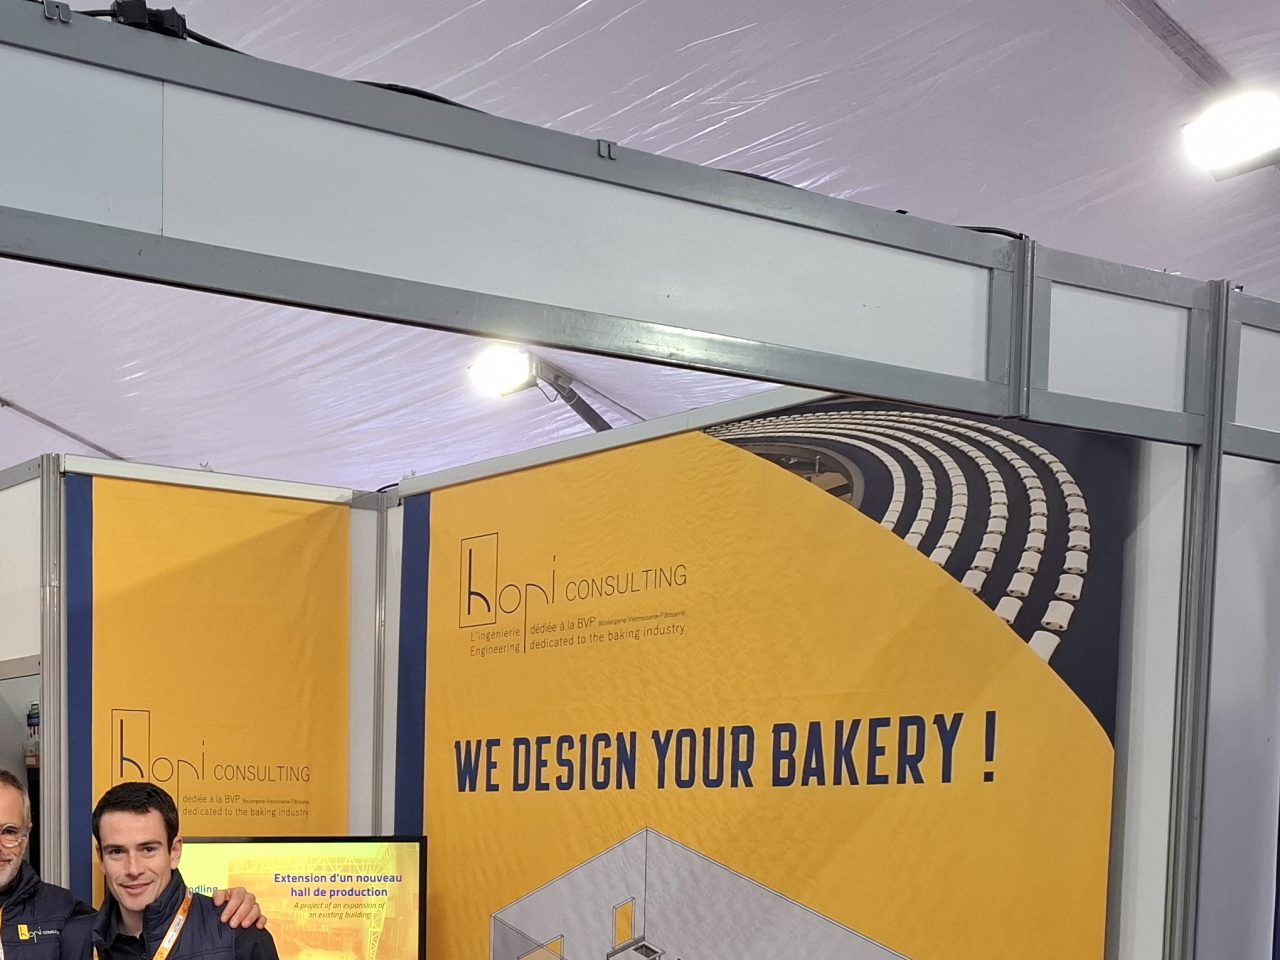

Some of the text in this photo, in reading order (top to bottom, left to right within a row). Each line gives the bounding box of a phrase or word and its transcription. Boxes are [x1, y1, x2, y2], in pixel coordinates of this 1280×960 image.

[468, 548, 687, 654] hopi CONSULTING
[529, 621, 557, 636] dédiée
[567, 619, 575, 631] la
[577, 616, 596, 630] BVP
[470, 623, 686, 658] Engineering dedicated to the baking industry
[453, 710, 997, 793] WE DESIGN YOUR BAKERY !
[213, 763, 311, 783] CONSULTING
[224, 794, 241, 804] BVP
[182, 806, 309, 819] dedicated to the baking industry
[274, 873, 402, 884] Extension d'un nouveau
[290, 887, 388, 900] hall de production
[300, 901, 323, 912] project
[343, 902, 377, 912] expansion
[318, 911, 344, 921] existing
[344, 911, 372, 921] building
